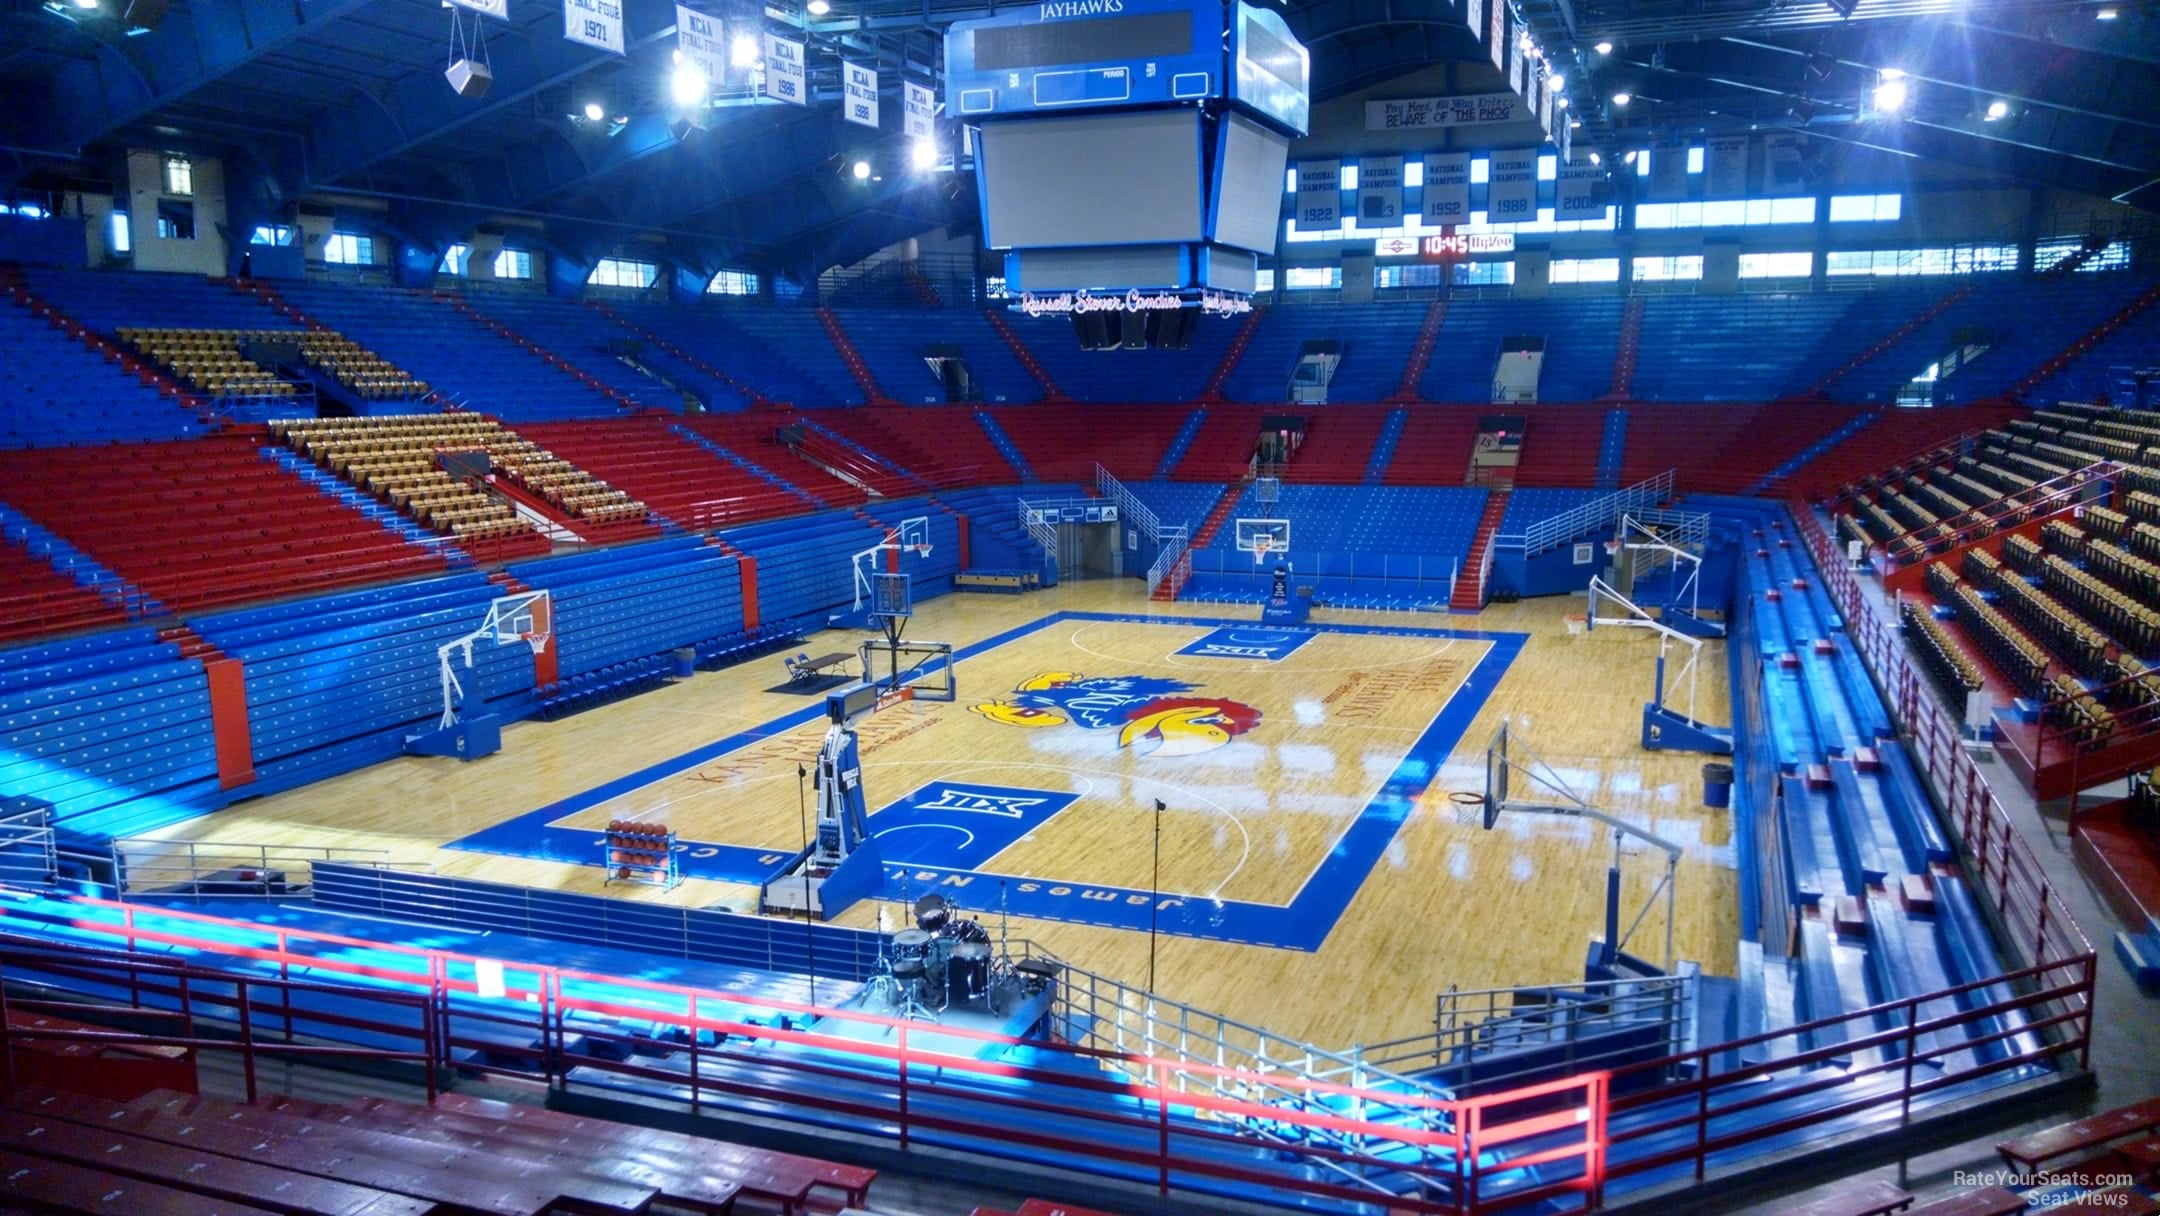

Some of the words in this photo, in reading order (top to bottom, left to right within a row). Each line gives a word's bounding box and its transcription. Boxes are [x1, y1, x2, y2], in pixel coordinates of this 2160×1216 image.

[1040, 0, 1124, 22] JAYHAWKS
[585, 19, 607, 41] 1971
[689, 15, 713, 37] NCAA
[1103, 70, 1125, 79] PERIOD
[778, 79, 795, 97] 1986
[1386, 112, 1427, 128] BEWARE
[1433, 111, 1449, 124] OF
[1364, 167, 1399, 177] NATIONAL
[1430, 164, 1464, 174] NATIONAL
[1495, 160, 1531, 170] NATIONAL
[1302, 171, 1336, 181] NATIONAL
[1304, 207, 1333, 222] 1922
[1431, 202, 1461, 216] 1952
[1497, 200, 1527, 213] 1988
[1425, 235, 1468, 254] 10:45
[1020, 291, 1073, 317] Russell
[1075, 289, 1126, 313] Stover
[1126, 287, 1182, 313] Candies
[1017, 883, 1185, 910] James
